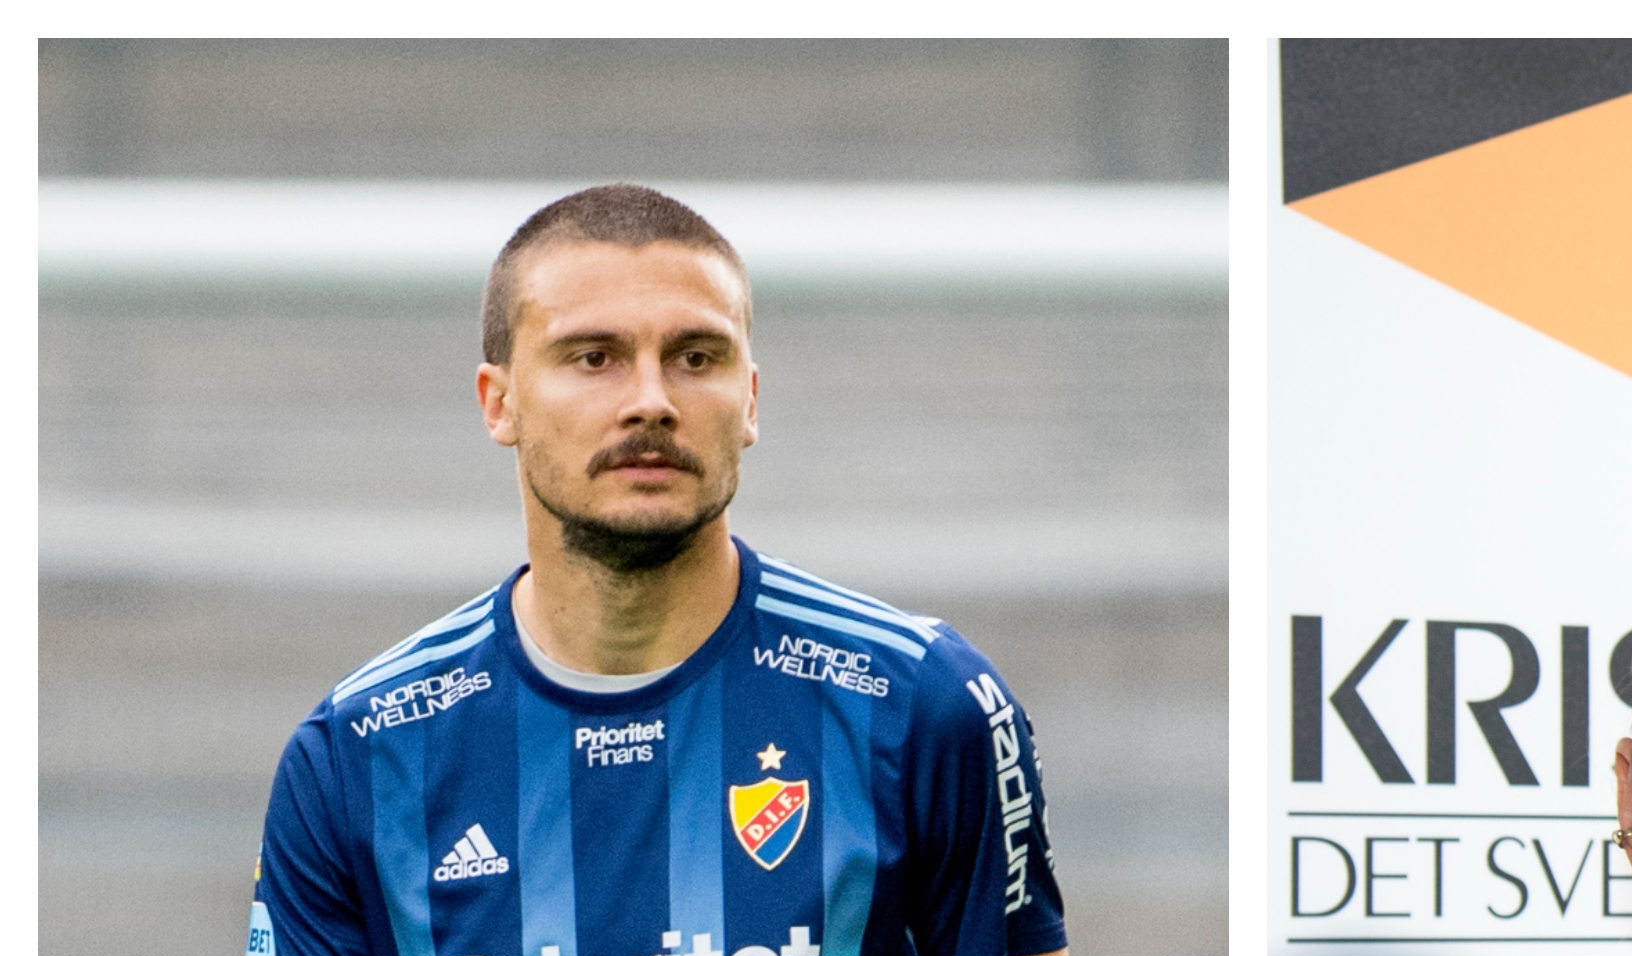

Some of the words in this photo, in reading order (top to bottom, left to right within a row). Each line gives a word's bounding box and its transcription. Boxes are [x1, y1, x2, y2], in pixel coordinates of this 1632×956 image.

[753, 646, 889, 698] WELLNESS
[778, 634, 871, 673] NORDIC
[350, 671, 492, 738] WELLNESS
[369, 667, 465, 712] NORDIC
[574, 719, 665, 749] Prioritet
[587, 744, 654, 768] Finans
[433, 856, 510, 882] adidas
[1291, 836, 1460, 918] DET
